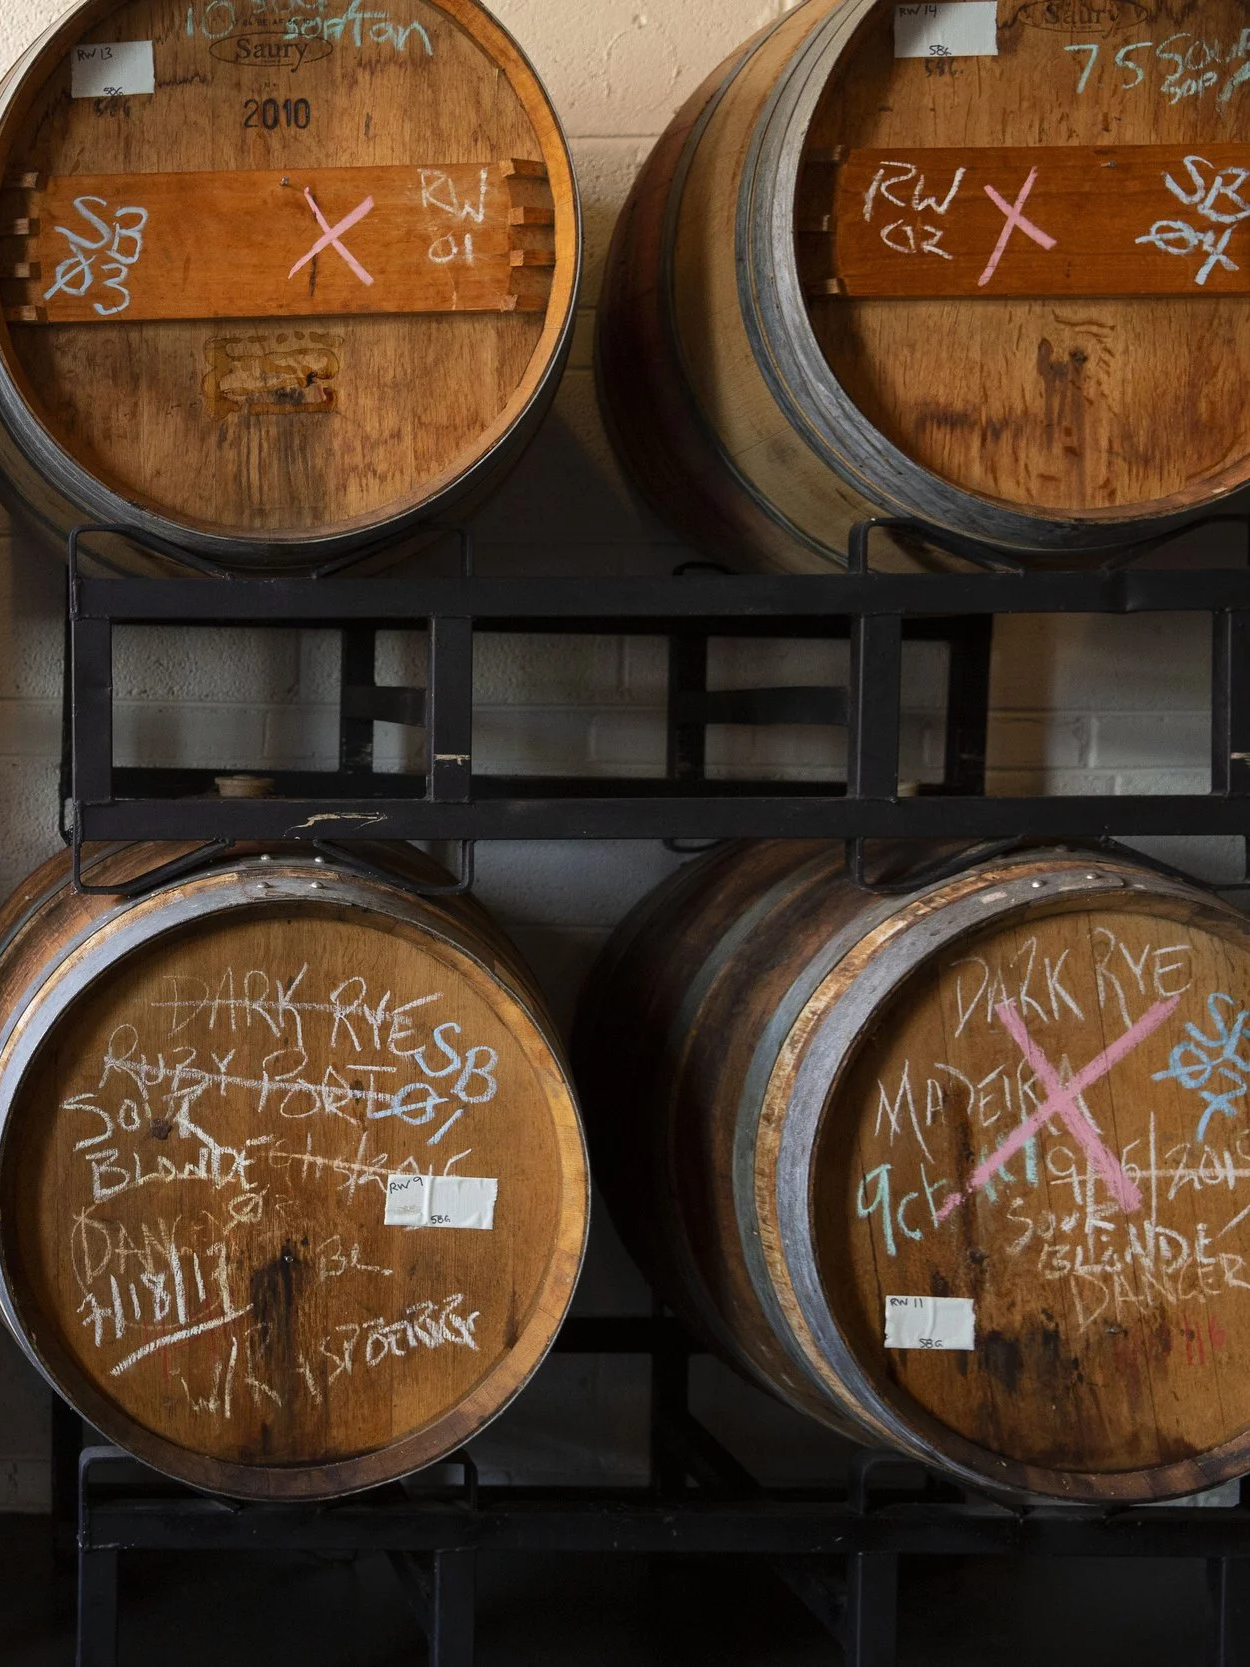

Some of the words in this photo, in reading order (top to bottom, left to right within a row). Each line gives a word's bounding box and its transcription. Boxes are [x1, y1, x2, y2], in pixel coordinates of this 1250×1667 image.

[899, 6, 921, 17] RW
[924, 5, 938, 18] 14
[1045, 2, 1120, 39] Saury
[77, 49, 97, 62] RW
[235, 38, 309, 73] Saury
[243, 98, 311, 130] 2010
[417, 167, 489, 225] RW
[862, 160, 967, 222] RW
[55, 195, 149, 266] SB
[951, 936, 1086, 1038] DARK
[1093, 927, 1192, 1031] RYE
[162, 962, 309, 1042] DARK
[330, 976, 444, 1055] RYE
[414, 1022, 499, 1103] SB
[389, 1179, 413, 1194] RW
[413, 1176, 424, 1188] 9
[890, 1297, 909, 1307] RW
[914, 1297, 924, 1309] 11
